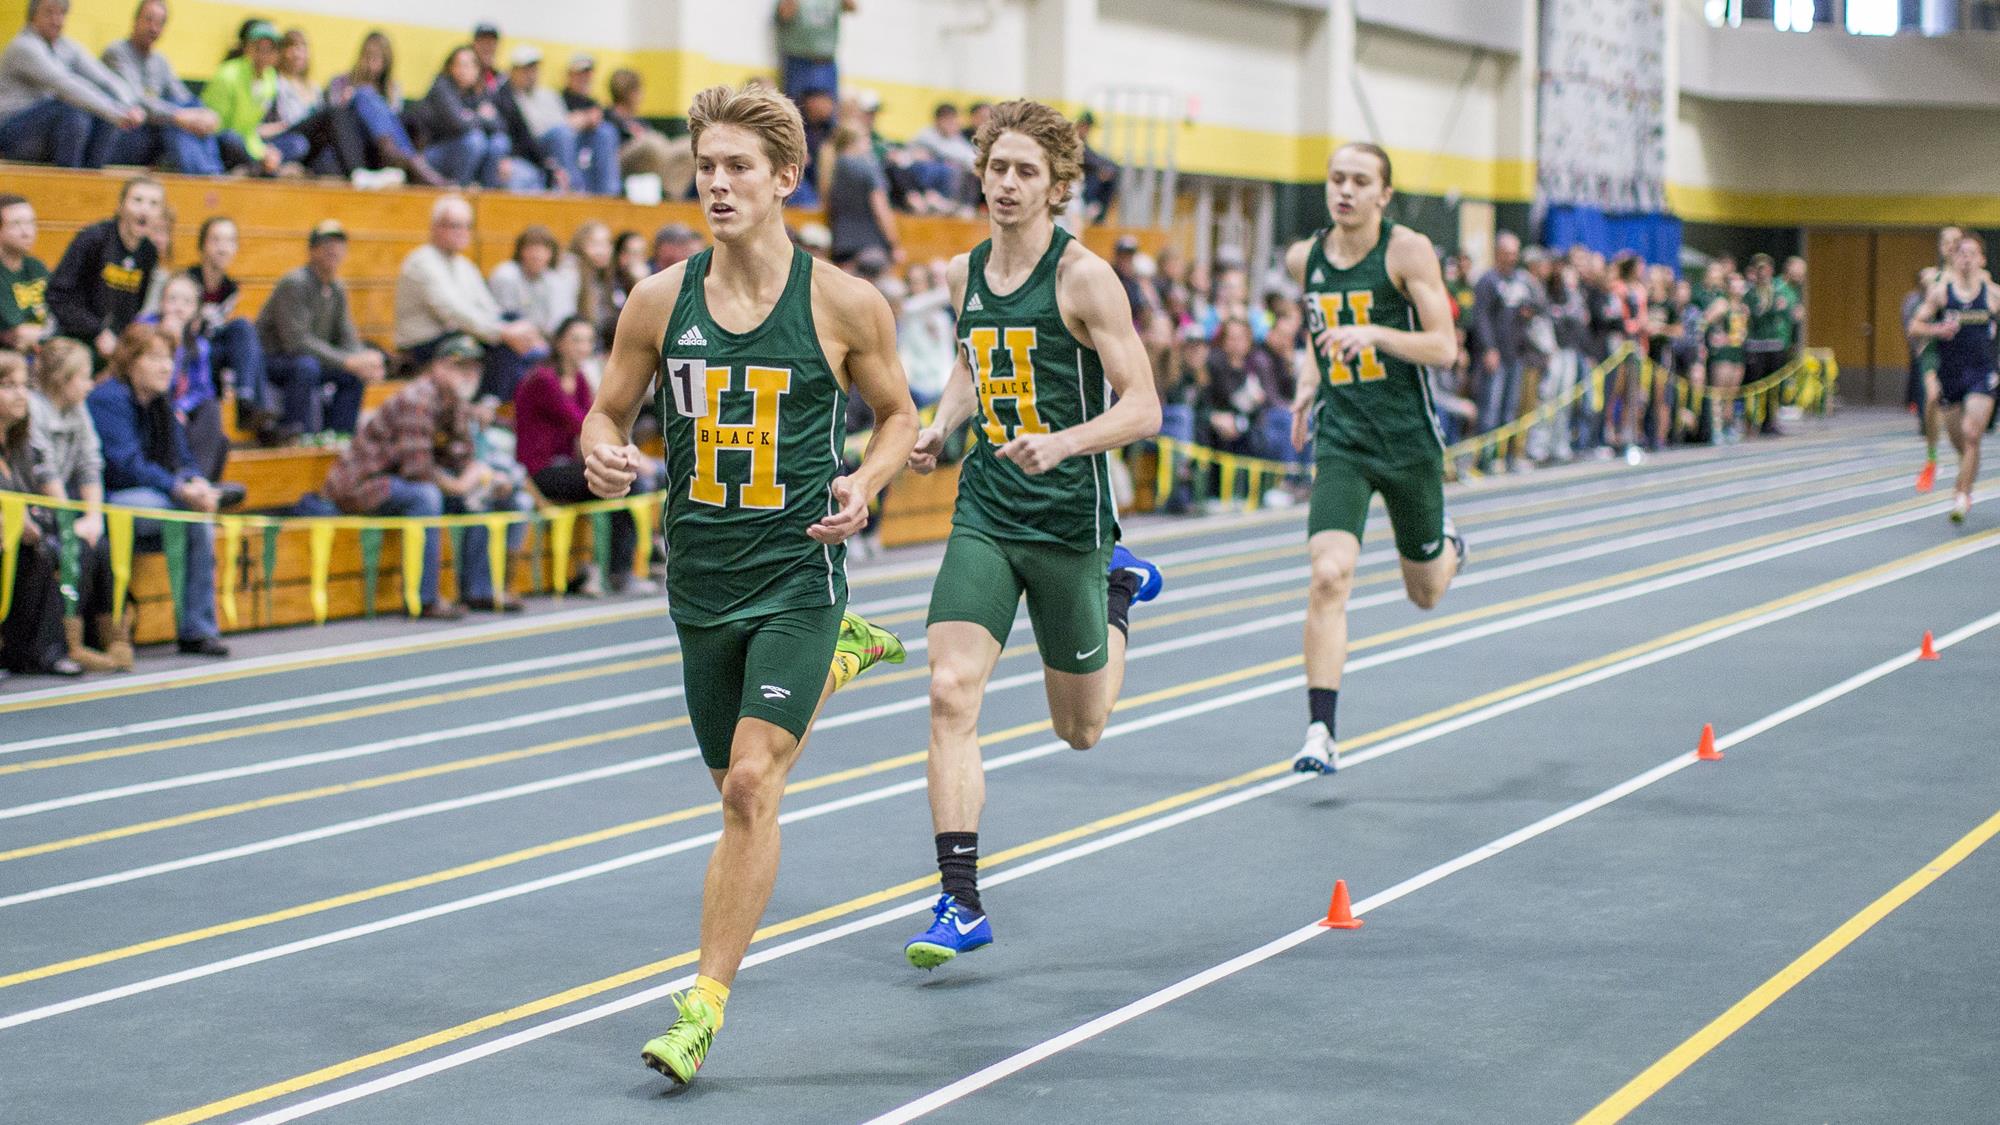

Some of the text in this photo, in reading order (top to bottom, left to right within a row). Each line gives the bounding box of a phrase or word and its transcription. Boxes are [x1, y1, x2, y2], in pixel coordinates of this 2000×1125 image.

[678, 338, 707, 346] adidas
[673, 363, 693, 413] 1
[970, 327, 1050, 446] H
[981, 381, 1030, 395] BLACK
[689, 366, 791, 509] H
[701, 429, 770, 445] BLACK
